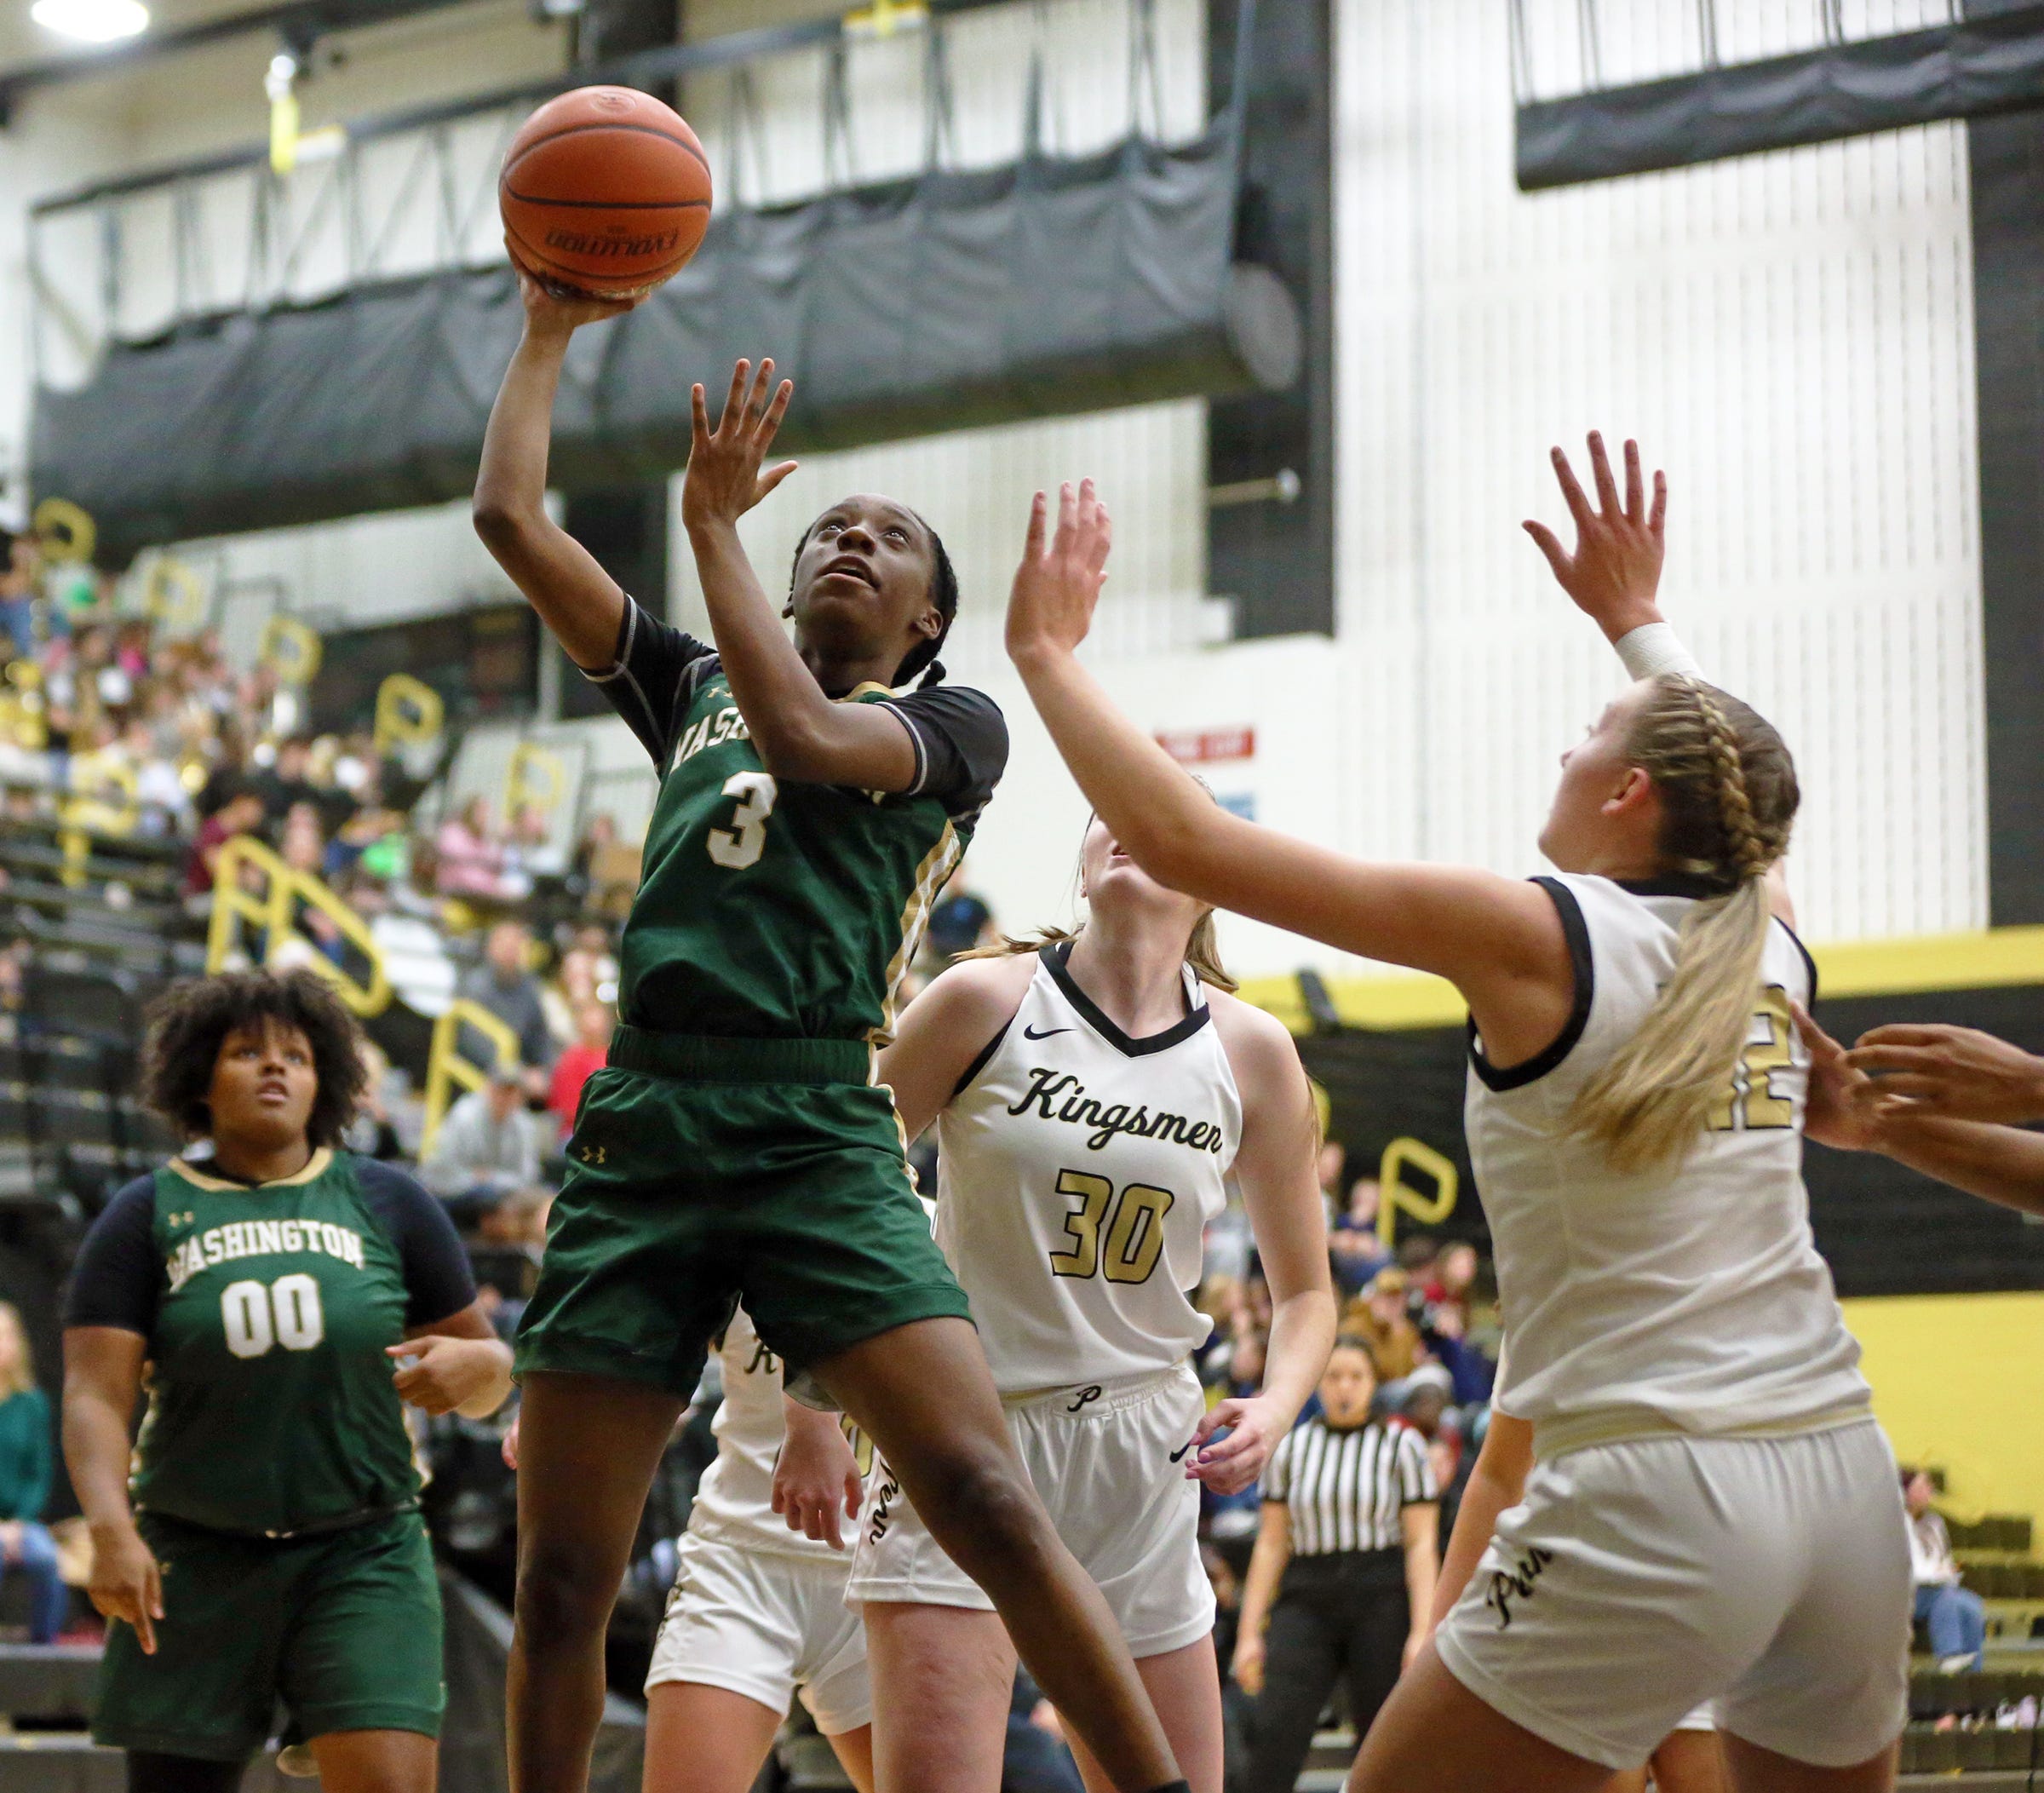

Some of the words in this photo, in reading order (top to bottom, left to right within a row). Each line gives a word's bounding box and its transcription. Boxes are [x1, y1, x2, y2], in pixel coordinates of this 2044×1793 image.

[706, 770, 778, 871] 3
[1008, 1067, 1222, 1154] Kingsmen
[166, 1219, 365, 1294] WASHINGTON
[1048, 1168, 1174, 1284] 30
[221, 1273, 324, 1359] 00
[1067, 1385, 1102, 1412] P
